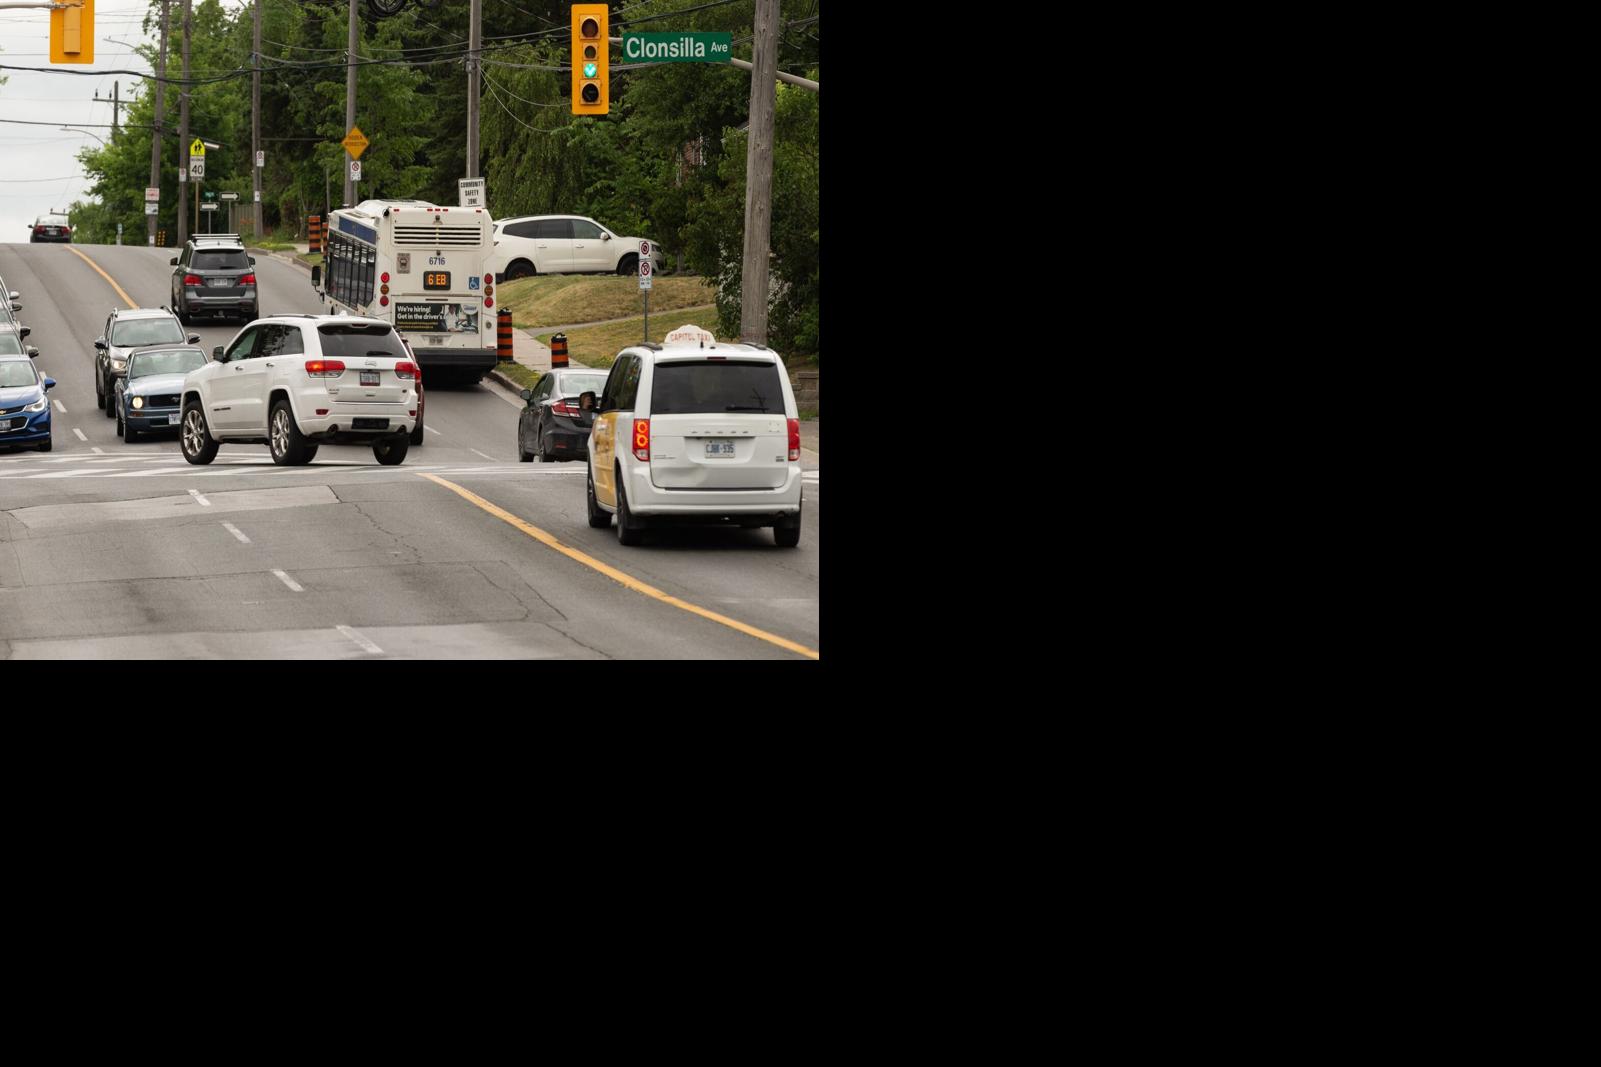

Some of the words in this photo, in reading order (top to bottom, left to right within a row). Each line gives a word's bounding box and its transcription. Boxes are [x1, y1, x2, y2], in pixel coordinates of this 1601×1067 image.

[626, 37, 705, 58] Clonsilla
[711, 42, 728, 52] Ave
[192, 165, 203, 175] 40
[429, 257, 446, 265] 6716
[428, 274, 434, 285] 6
[436, 274, 446, 285] EB
[413, 305, 432, 314] hiring!
